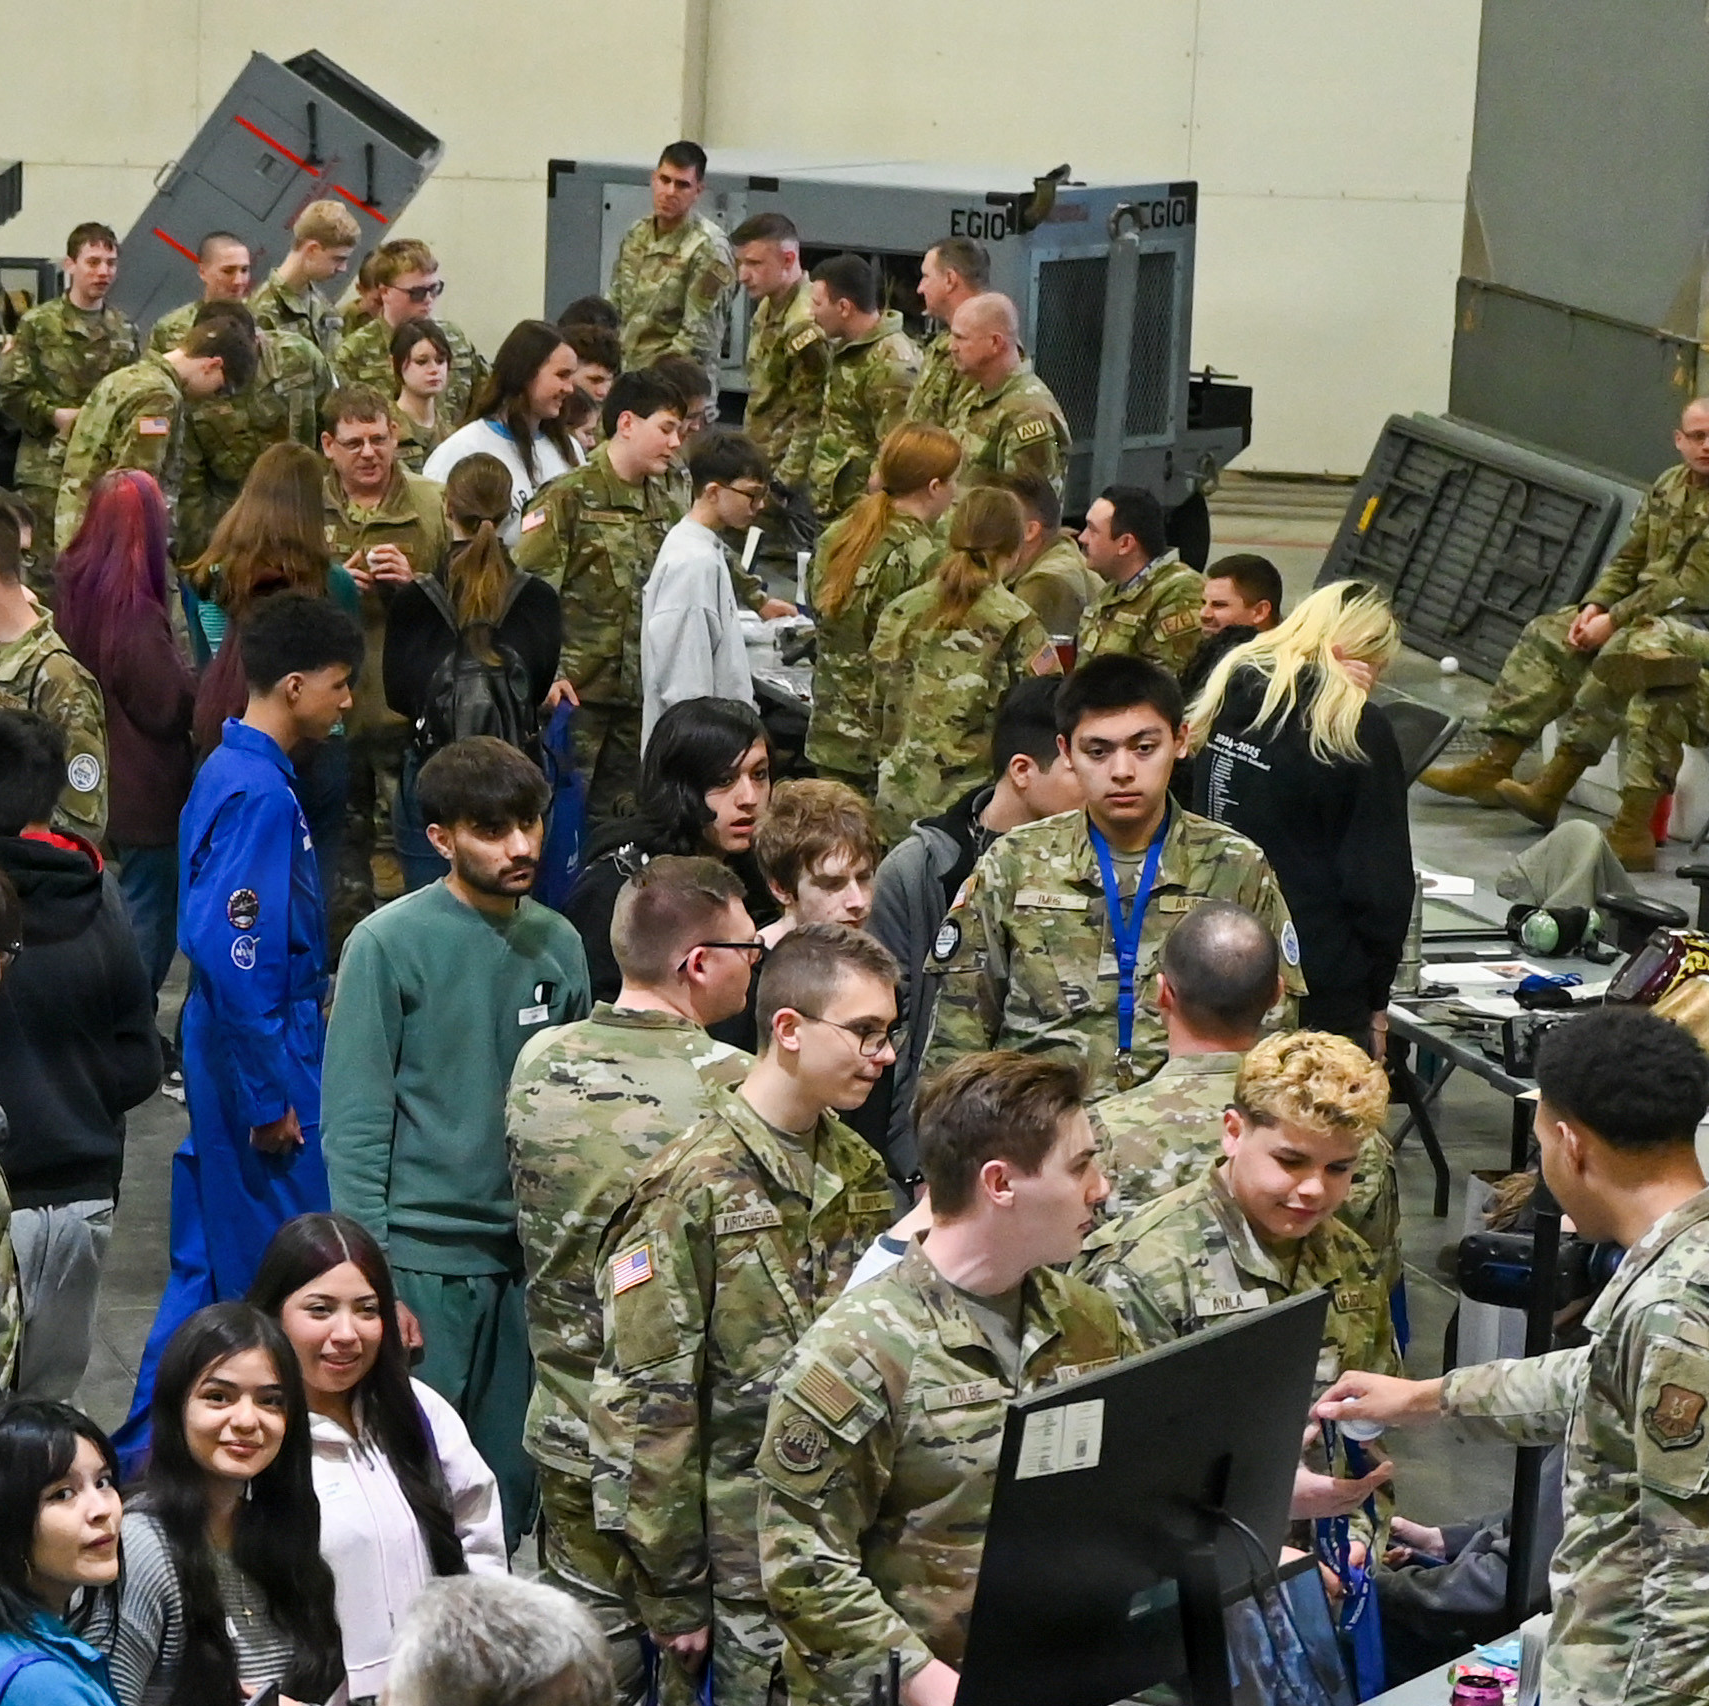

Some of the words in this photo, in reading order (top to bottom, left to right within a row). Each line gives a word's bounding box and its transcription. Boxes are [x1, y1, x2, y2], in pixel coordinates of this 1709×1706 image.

[1021, 420, 1044, 438] AVI
[1214, 732, 1261, 759] 2024-2025
[1213, 1294, 1245, 1312] AYALA
[948, 1384, 984, 1406] KOLBE
